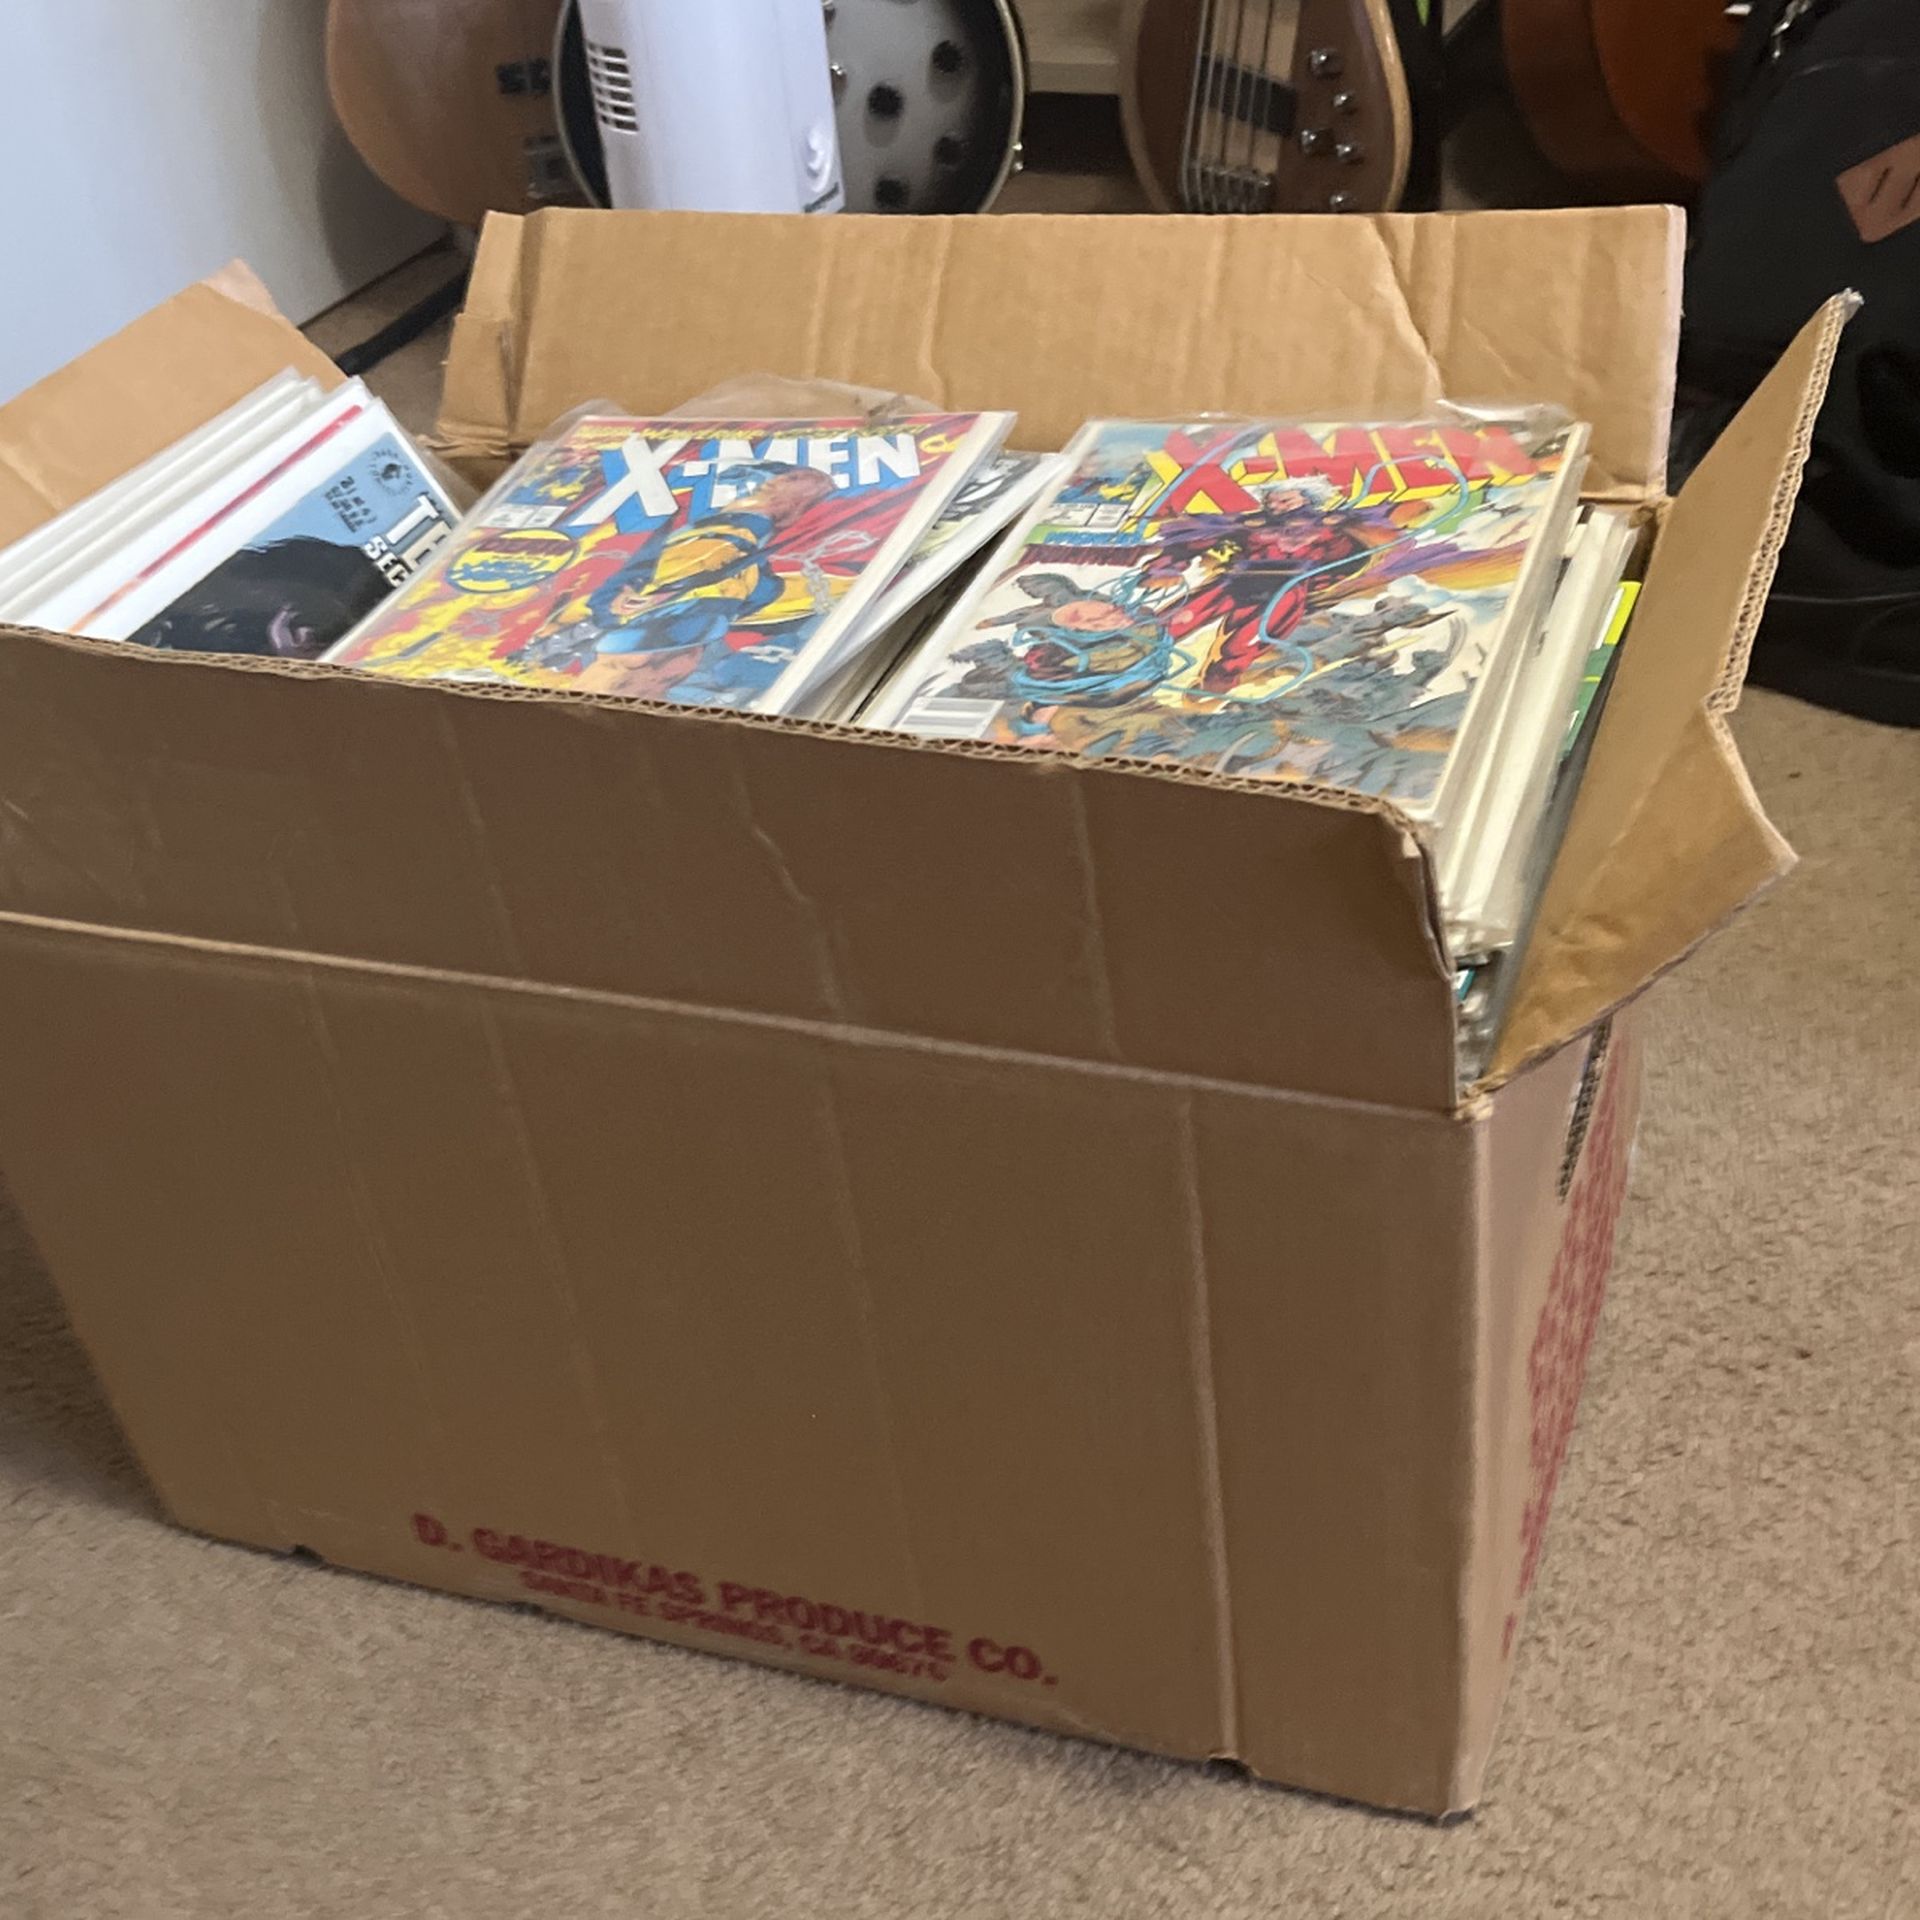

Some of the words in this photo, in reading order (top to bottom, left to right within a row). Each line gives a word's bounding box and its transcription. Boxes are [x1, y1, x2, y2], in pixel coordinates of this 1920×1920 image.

[568, 431, 921, 526] X-MEN
[1143, 425, 1540, 517] X-MEN
[718, 1581, 957, 1664] PRODUCE
[967, 1637, 1060, 1687] CO.
